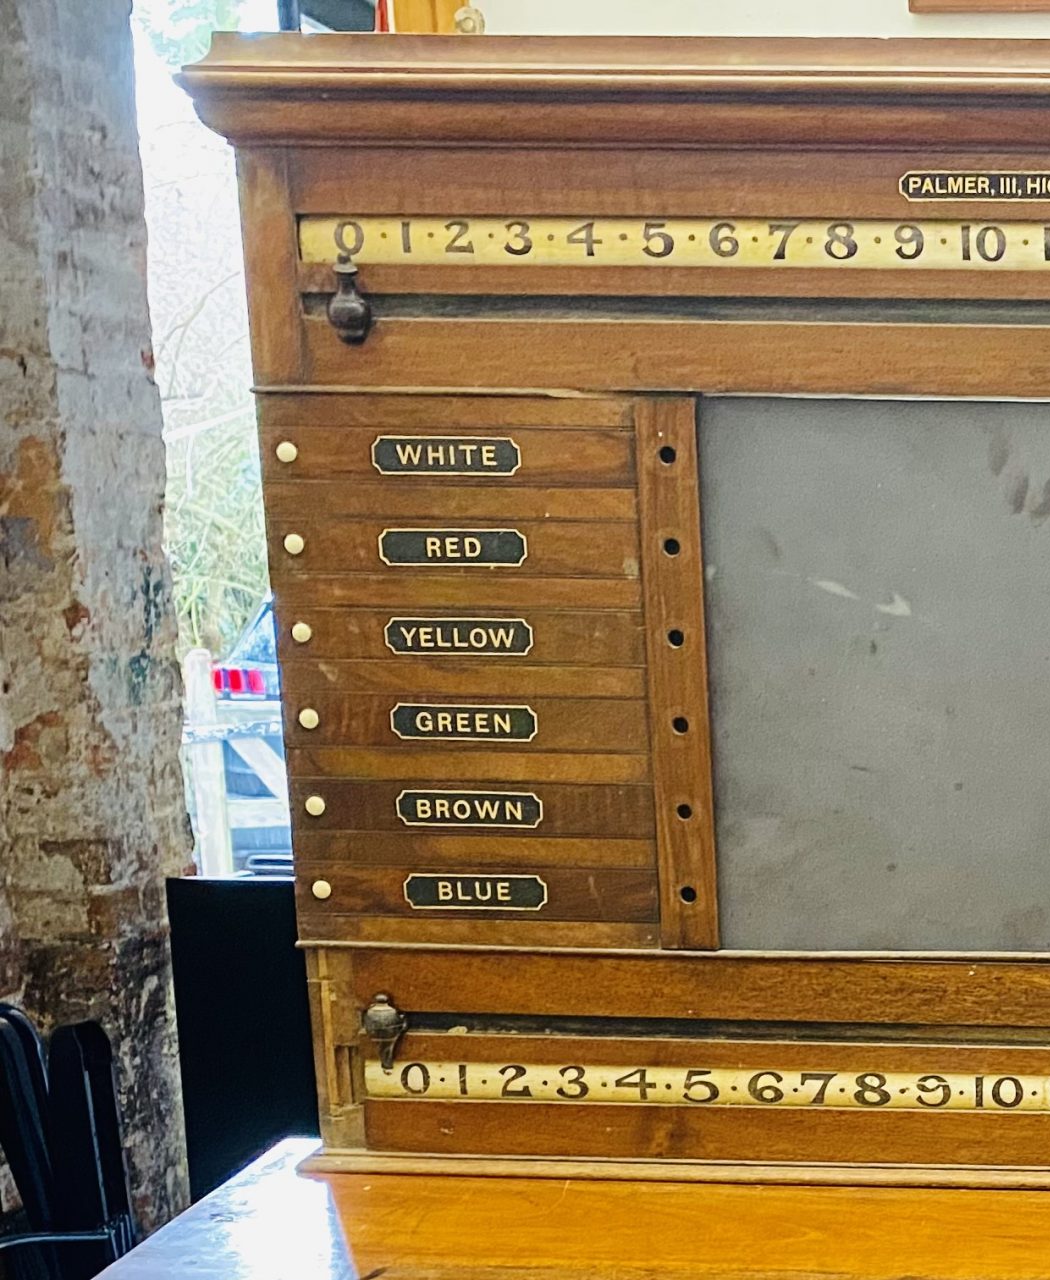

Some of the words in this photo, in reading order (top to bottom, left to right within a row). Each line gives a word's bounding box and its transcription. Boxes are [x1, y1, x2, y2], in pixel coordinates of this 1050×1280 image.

[908, 176, 995, 196] PALMER,
[334, 222, 365, 256] 0
[444, 222, 475, 254] 2
[504, 222, 534, 256] 3
[566, 222, 603, 257] 4
[642, 222, 675, 258] 5
[708, 222, 740, 258] 6
[770, 223, 797, 260] 7
[825, 223, 859, 260] 8
[894, 224, 925, 260] 9
[962, 225, 1006, 261] 10
[395, 444, 498, 467] WHITE
[426, 537, 482, 558] RED
[400, 627, 515, 648] YELLOW
[415, 711, 512, 733] GREEN
[416, 800, 523, 820] BROWN
[437, 881, 512, 902] BLUE
[400, 1062, 431, 1095] 0
[499, 1064, 533, 1098] 2
[556, 1066, 590, 1099] 3
[614, 1068, 657, 1101] 4
[683, 1069, 720, 1104] 5
[748, 1071, 784, 1104] 6
[800, 1072, 838, 1105] 7
[854, 1073, 891, 1108] 8
[916, 1075, 951, 1108] 9
[975, 1076, 1024, 1108] 10
